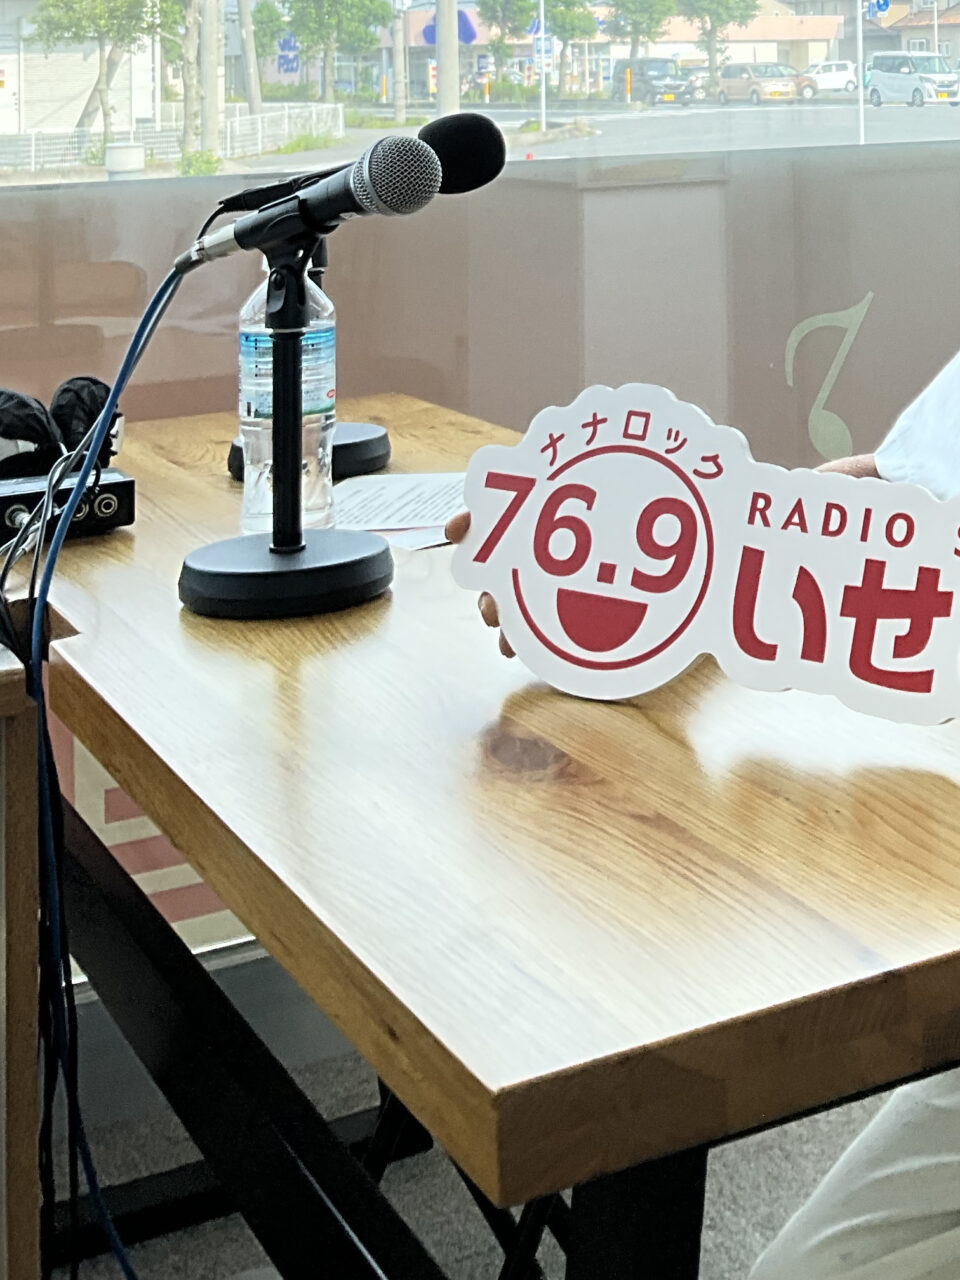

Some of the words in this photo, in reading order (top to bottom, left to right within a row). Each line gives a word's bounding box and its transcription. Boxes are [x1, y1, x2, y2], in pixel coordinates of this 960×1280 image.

[540, 410, 724, 480] ナナロック
[472, 471, 698, 594] 76.9
[747, 491, 915, 548] RADIO
